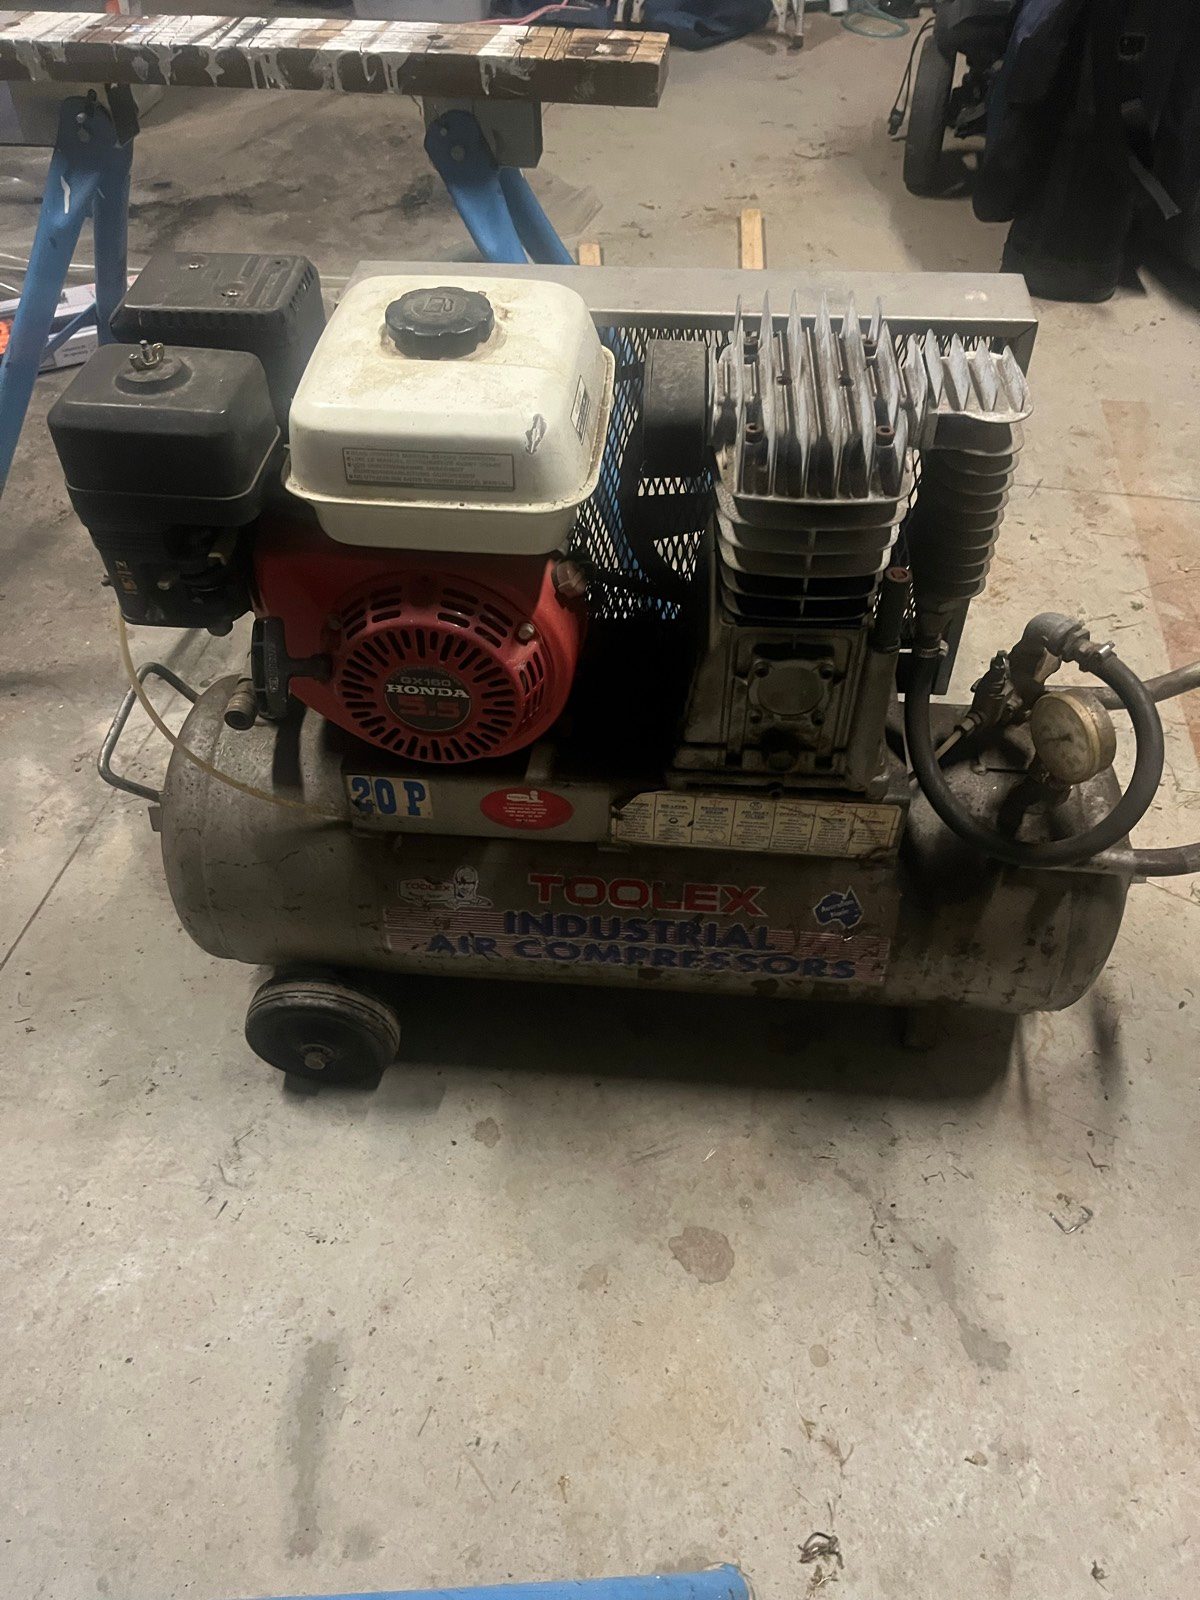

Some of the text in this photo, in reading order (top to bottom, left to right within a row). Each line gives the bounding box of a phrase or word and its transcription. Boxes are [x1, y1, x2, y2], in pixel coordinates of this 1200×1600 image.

[385, 683, 470, 698] HONDA
[529, 872, 767, 917] TOOLEX
[503, 911, 775, 950] INDUSTRIAL
[428, 934, 856, 979] AIR COMPRESSORS
